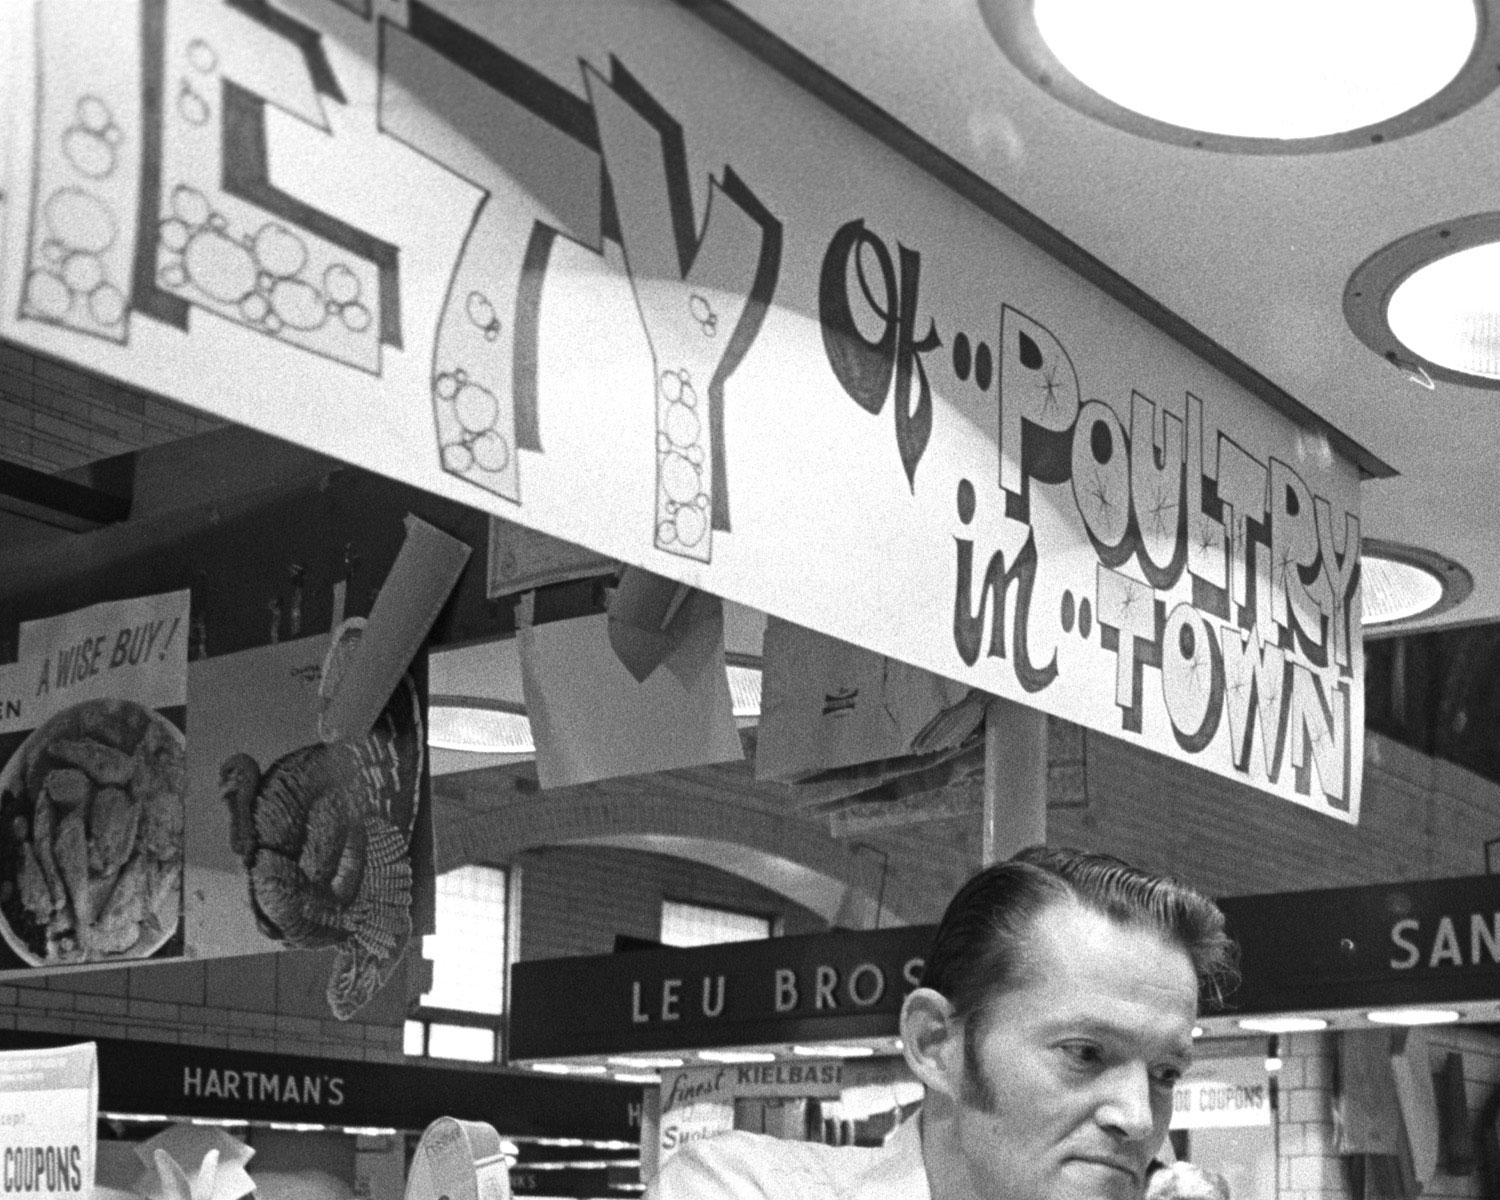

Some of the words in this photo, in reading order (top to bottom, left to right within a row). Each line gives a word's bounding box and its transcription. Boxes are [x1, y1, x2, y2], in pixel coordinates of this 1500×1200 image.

[35, 658, 51, 697] A
[56, 635, 106, 689] WISE
[108, 616, 181, 670] BUY!
[1096, 561, 1354, 814] TOWN
[631, 974, 727, 1024] LEU
[182, 1066, 346, 1107] HARTMAN'S
[1199, 1084, 1264, 1113] COUPONS
[3, 1143, 83, 1193] COUPONS
